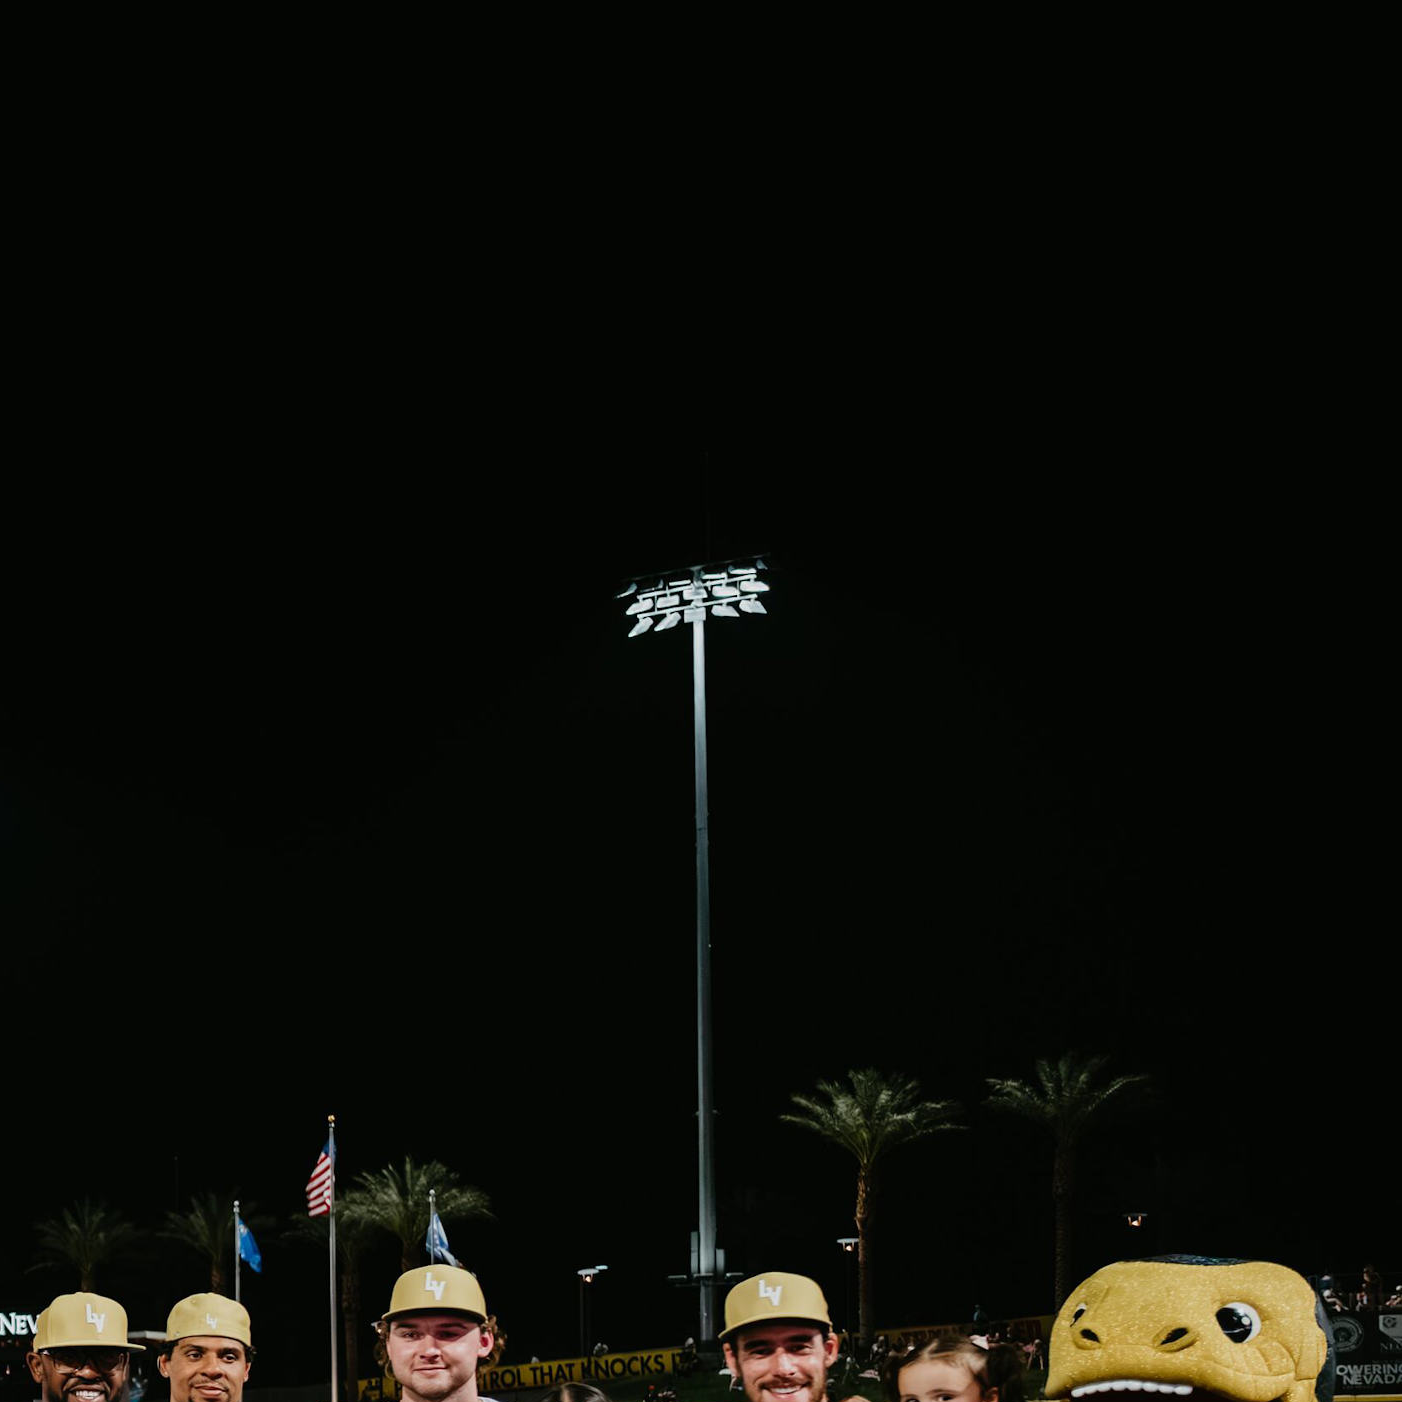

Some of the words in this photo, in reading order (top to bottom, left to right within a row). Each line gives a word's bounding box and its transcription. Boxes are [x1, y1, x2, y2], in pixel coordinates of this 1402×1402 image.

[425, 1272, 446, 1301] LV
[758, 1278, 783, 1308] LV
[86, 1303, 107, 1334] LV
[530, 1363, 575, 1384] THAT
[580, 1353, 666, 1380] KNOCKS
